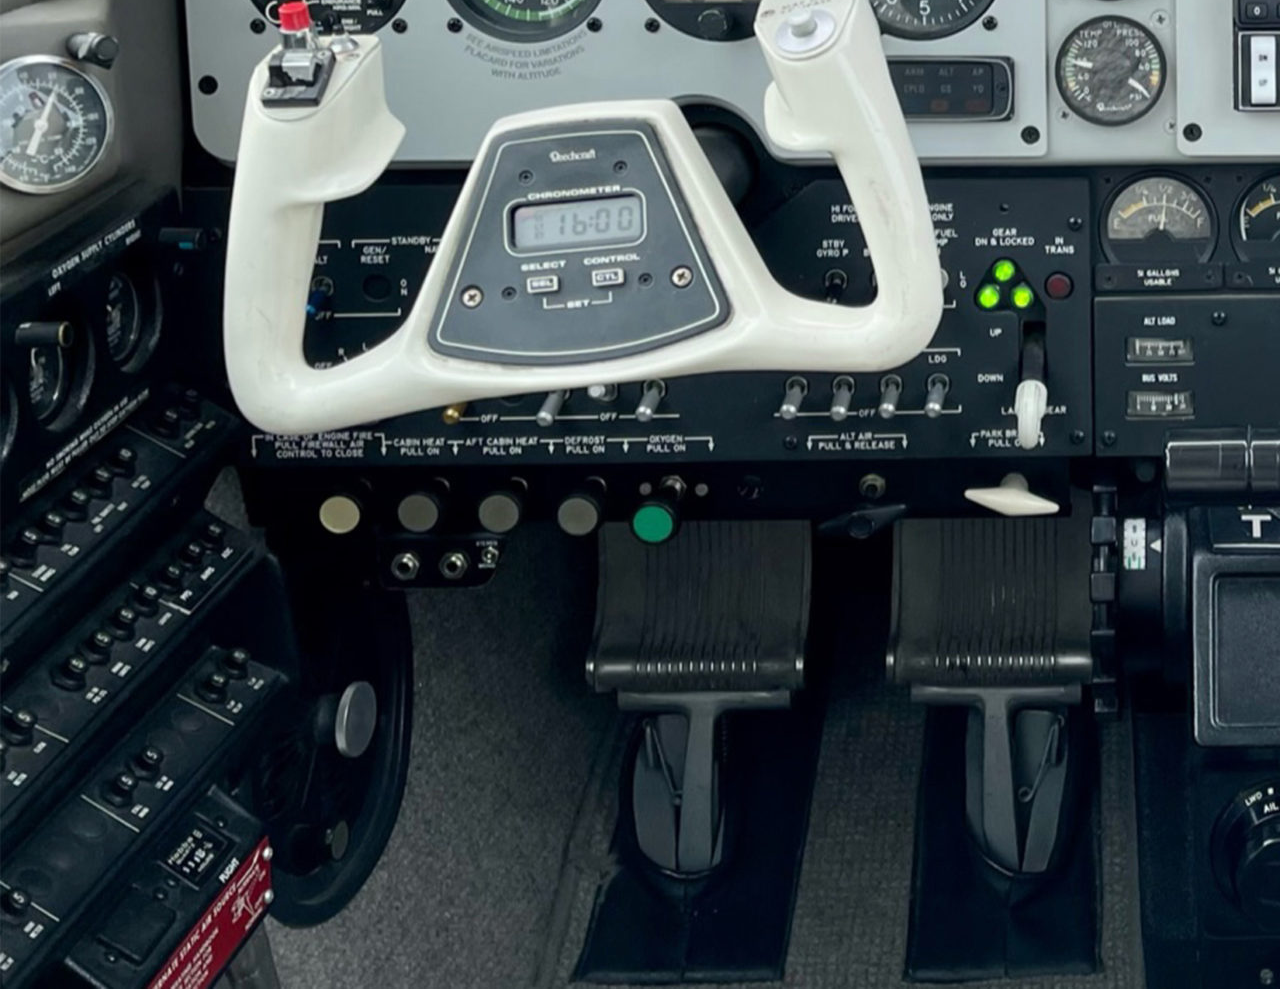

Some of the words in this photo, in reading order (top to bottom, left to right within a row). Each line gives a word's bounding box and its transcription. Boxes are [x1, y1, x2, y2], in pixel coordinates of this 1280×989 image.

[919, 0, 930, 15] 5
[1254, 7, 1261, 15] 0
[485, 43, 532, 59] AIRSPEED
[533, 30, 588, 58] LIMITATIONS
[464, 46, 508, 67] PLACARD
[508, 60, 530, 69] FOR
[530, 45, 586, 68] VARIATIONS
[491, 68, 516, 80] WITH
[518, 67, 562, 80] ALTITUDE
[528, 185, 621, 201] CHRONOMETER
[992, 229, 1017, 237] GEAR
[391, 237, 432, 245] STANDBY
[822, 239, 845, 248] STBY
[975, 237, 988, 247] DN
[990, 238, 998, 246] &
[1000, 237, 1034, 246] LOCKED
[1054, 237, 1064, 245] IN
[364, 246, 387, 255] GEN/
[1045, 245, 1075, 255] TRANS
[360, 255, 390, 264] RESET
[584, 253, 640, 265] CONTROL
[521, 260, 566, 272] SELECT
[1146, 269, 1180, 277] GALLONS
[595, 273, 620, 283] CTL
[1144, 277, 1172, 286] USABLE
[532, 279, 551, 289] SEL
[566, 299, 590, 309] SET
[1144, 317, 1155, 325] ALT
[1158, 317, 1176, 325] LOAD
[990, 328, 1002, 337] UP
[928, 355, 947, 363] LDG
[978, 373, 1004, 383] DOWN
[1142, 374, 1156, 383] BUS
[1158, 373, 1178, 382] VOLTS
[564, 435, 605, 445] DEFROST
[649, 435, 683, 443] OXYGEN
[840, 431, 856, 440] ALT
[858, 431, 873, 440] AIR
[275, 441, 298, 449] PULL
[300, 441, 346, 449] FIREWALL
[350, 441, 364, 449] AIR
[393, 438, 420, 446] CABIN
[422, 438, 444, 446] HEAT
[818, 442, 841, 450] PULL
[844, 442, 851, 450] &
[854, 440, 896, 449] RELEASE
[400, 447, 424, 456] PULL
[427, 447, 440, 455] ON
[566, 445, 589, 454] PULL
[592, 445, 605, 453] ON
[647, 445, 670, 453] PULL
[673, 444, 686, 453] ON
[276, 449, 318, 458] CONTROL
[322, 449, 333, 458] TO
[336, 449, 364, 457] CLOSE
[1241, 515, 1272, 538] T
[1244, 791, 1263, 807] LWD
[1264, 802, 1279, 813] AIL
[219, 857, 240, 883] FLIGHT
